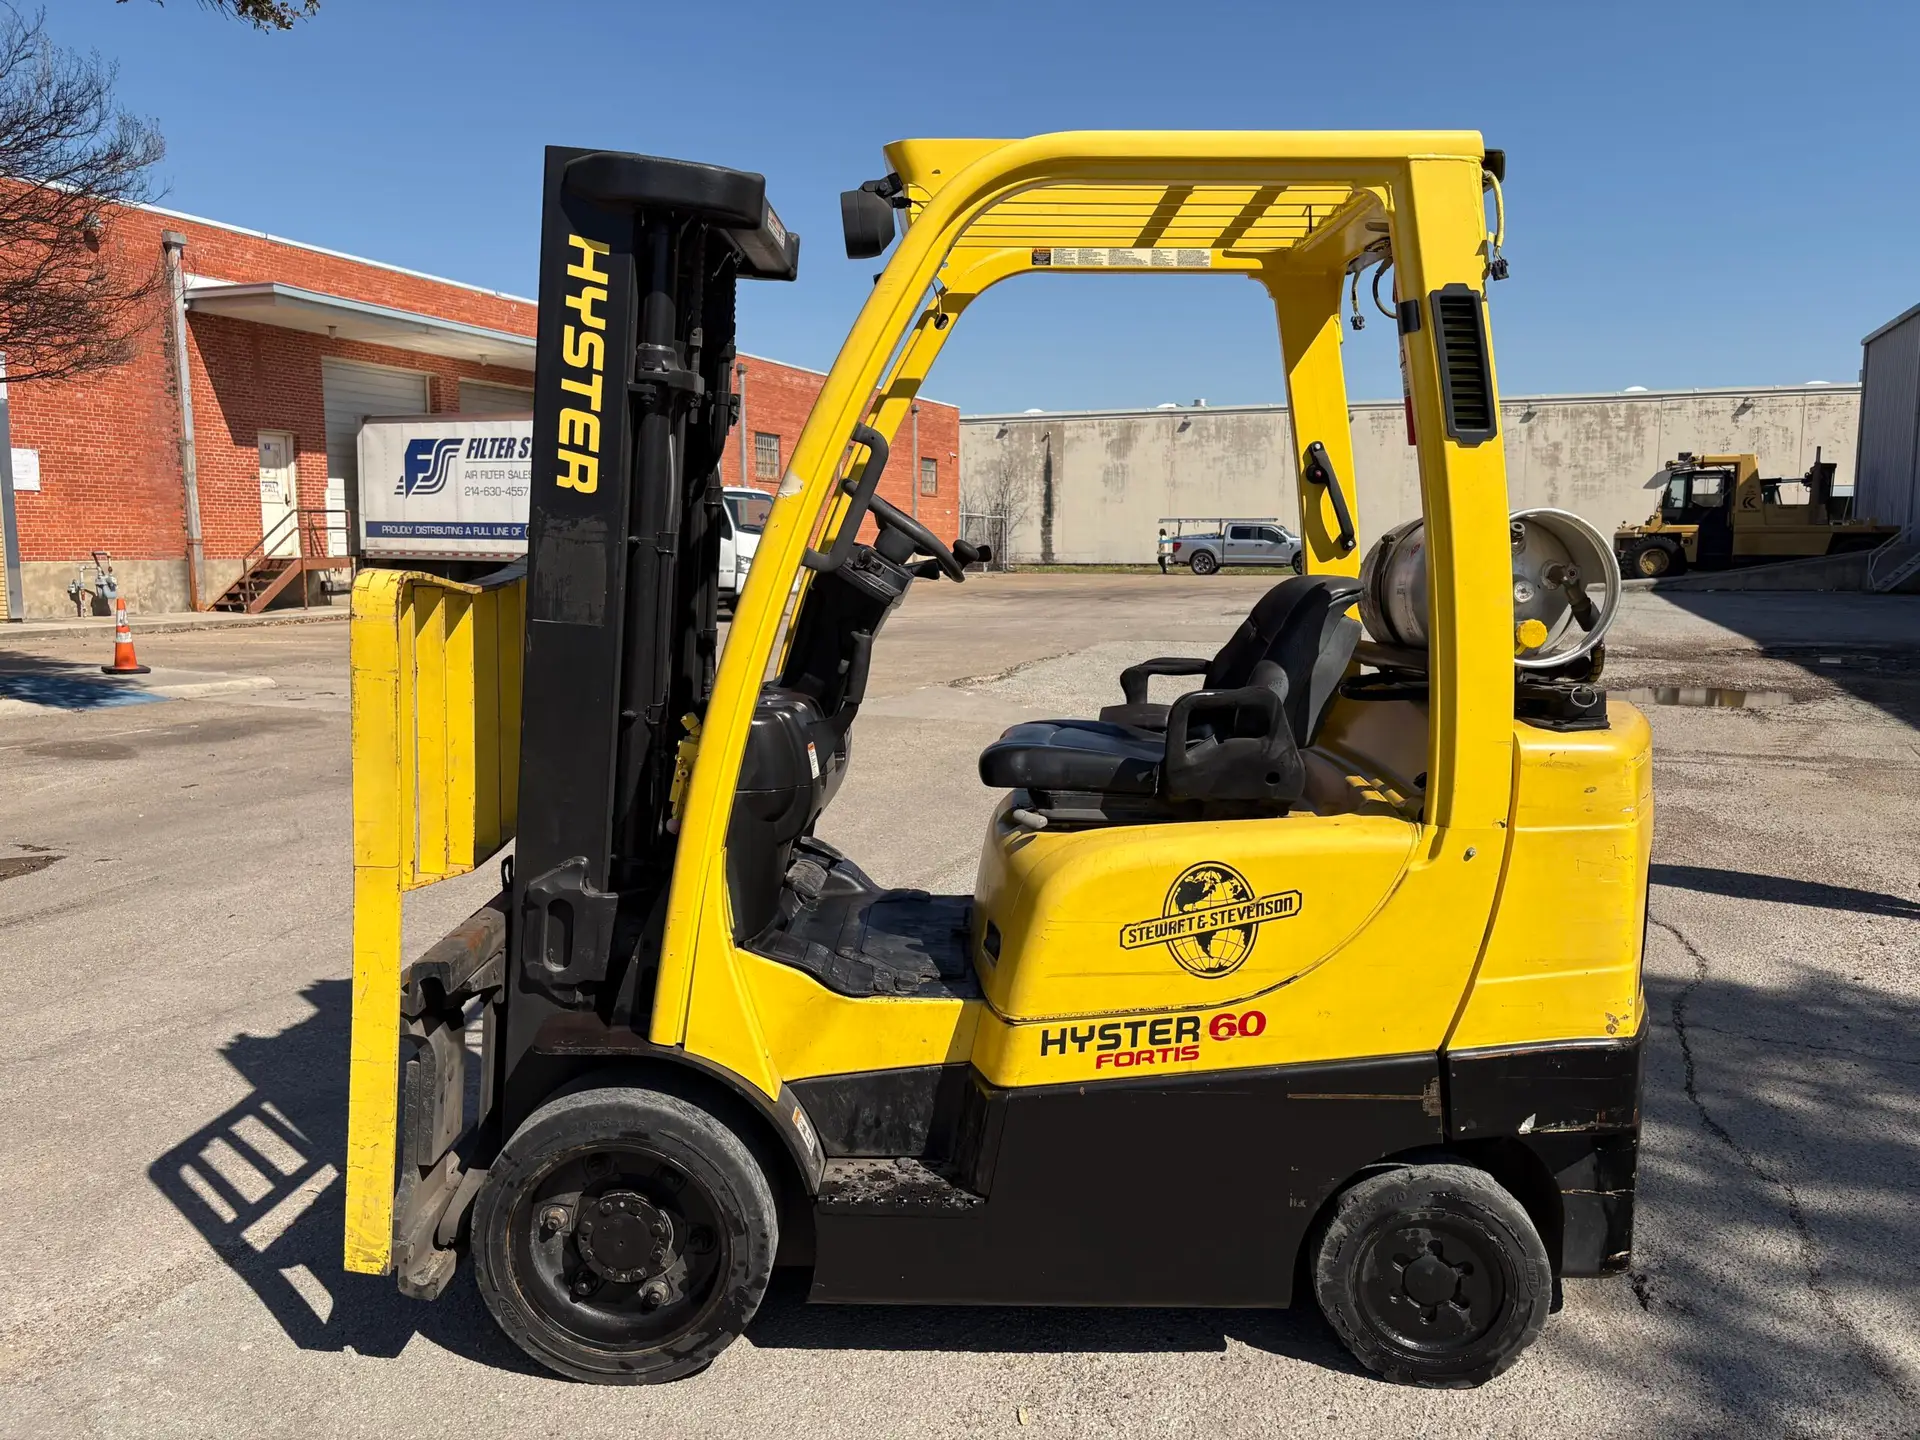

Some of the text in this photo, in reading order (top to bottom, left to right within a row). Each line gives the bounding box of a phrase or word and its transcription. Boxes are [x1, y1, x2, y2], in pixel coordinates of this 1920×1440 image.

[556, 234, 610, 494] HYSTER
[466, 437, 532, 459] FILTER S
[464, 470, 478, 479] AIR
[480, 470, 505, 479] FILTER
[464, 486, 529, 496] 214-630-4557
[381, 525, 413, 535] PROUDLY
[415, 526, 463, 535] DISTRIBUTING
[465, 527, 472, 535] A
[473, 527, 491, 535] FULL
[492, 527, 509, 536] LINE
[511, 527, 521, 536] OF
[1197, 914, 1208, 930] &
[1040, 1010, 1267, 1056] HYSTER 60
[1095, 1044, 1200, 1069] FORTIS
